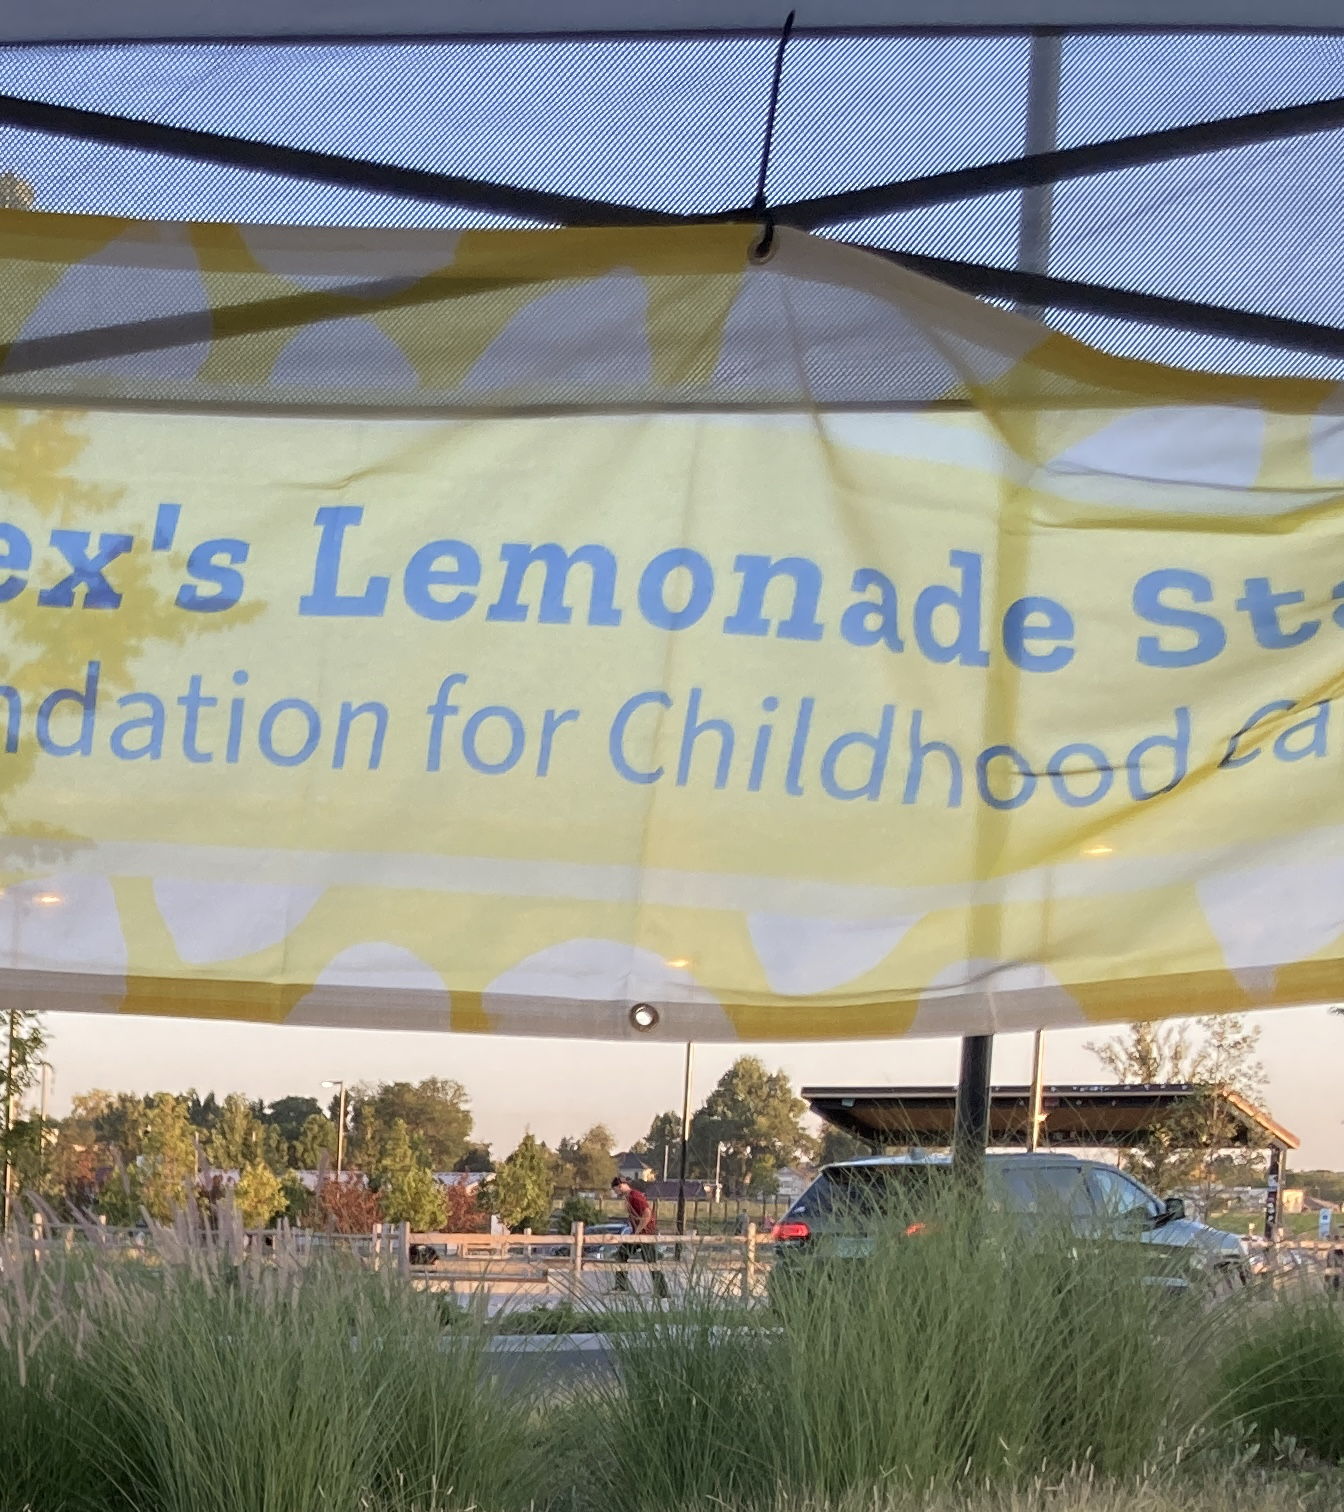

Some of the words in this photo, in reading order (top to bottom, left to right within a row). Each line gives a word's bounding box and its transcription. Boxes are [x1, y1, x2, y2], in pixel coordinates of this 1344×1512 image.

[298, 502, 1077, 673] Lemonade
[1132, 567, 1344, 669] St
[426, 673, 579, 778] for
[609, 685, 1192, 811] Childhood
[1217, 699, 1330, 769] ca
